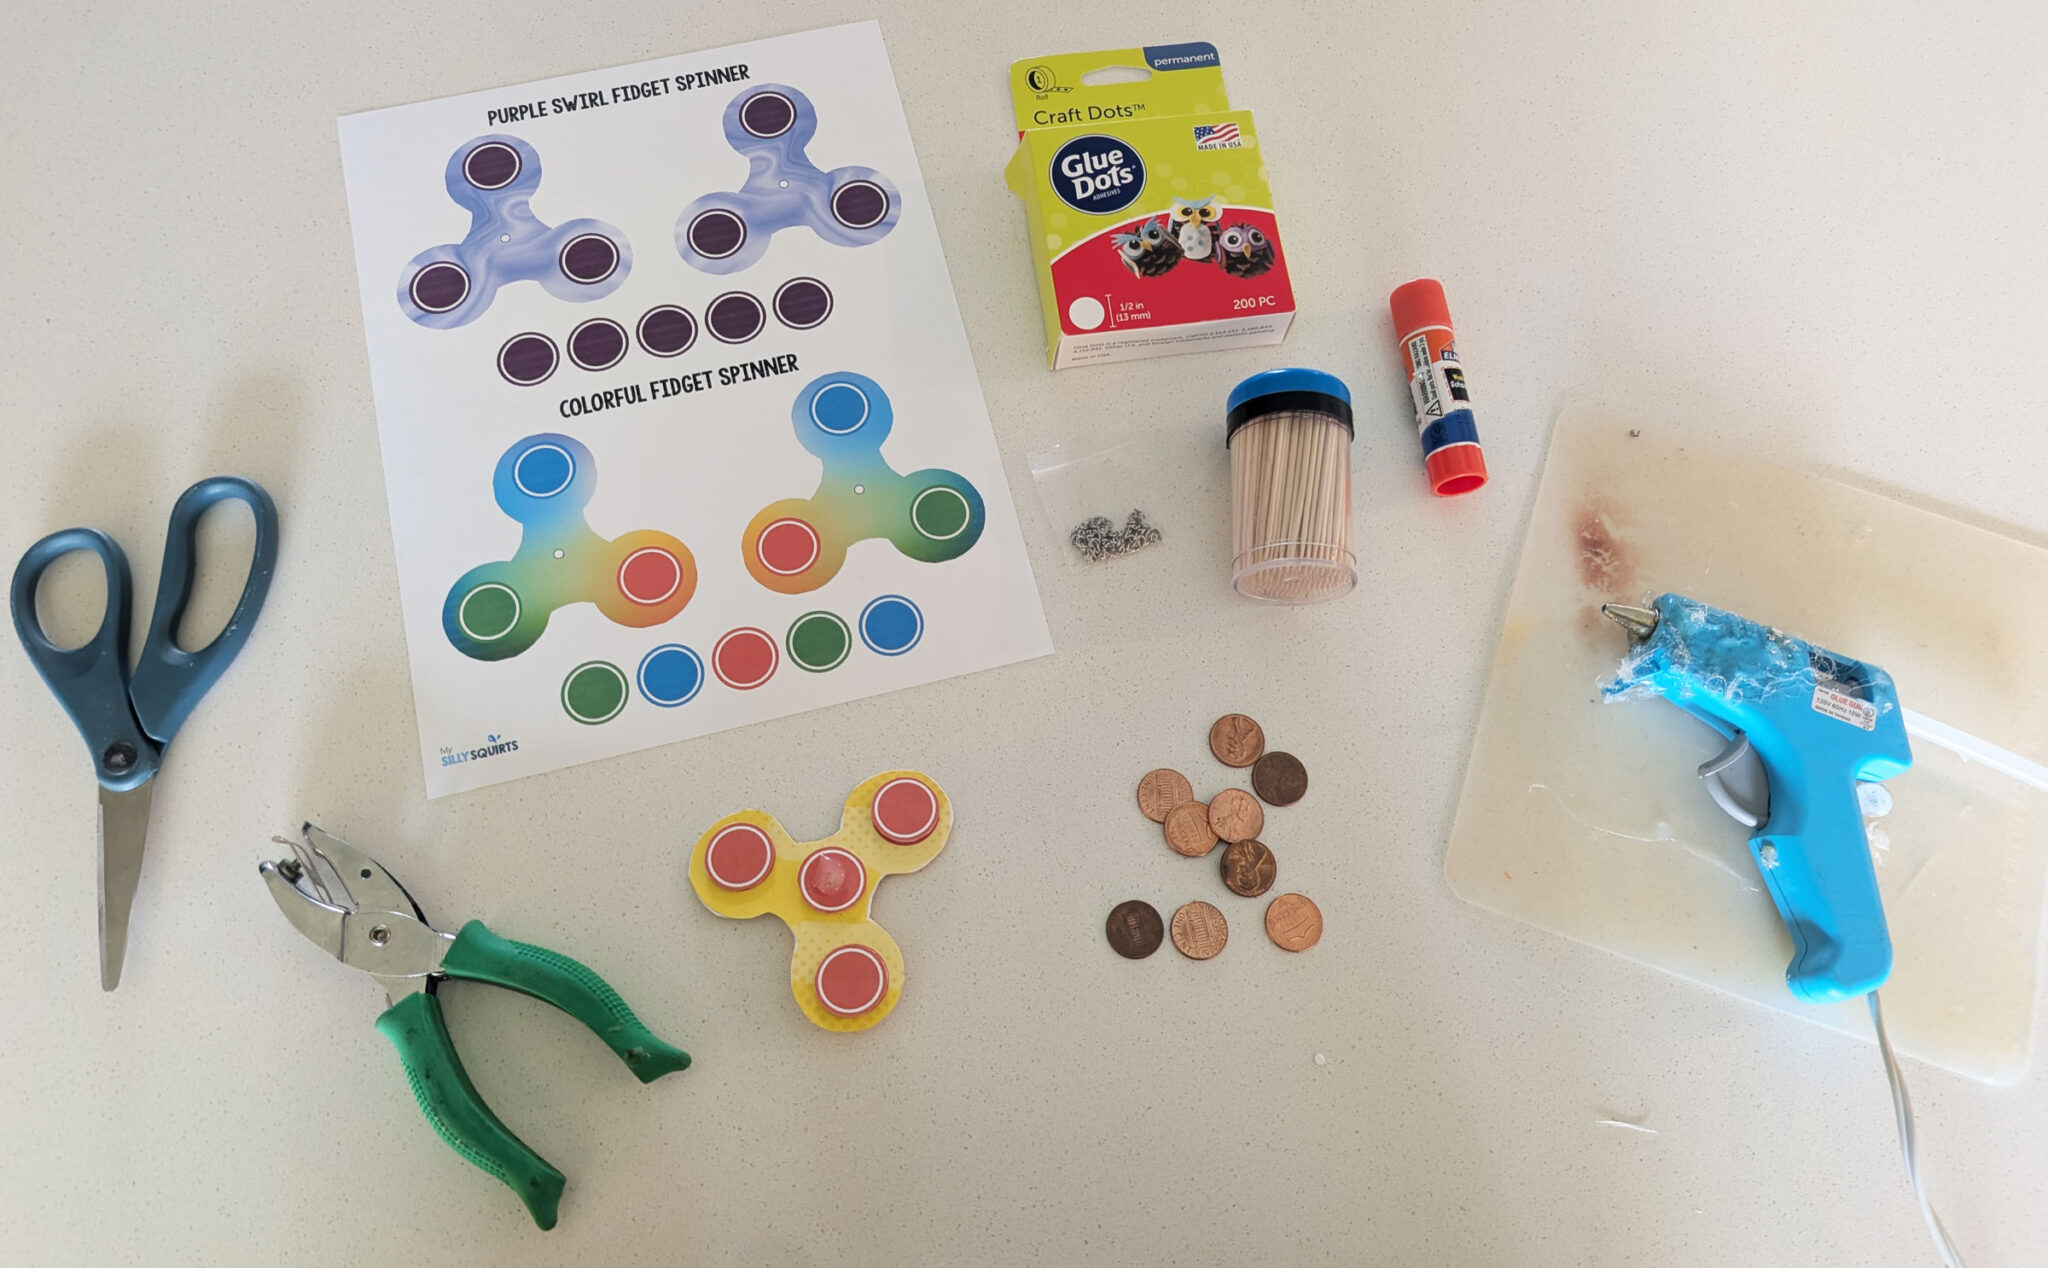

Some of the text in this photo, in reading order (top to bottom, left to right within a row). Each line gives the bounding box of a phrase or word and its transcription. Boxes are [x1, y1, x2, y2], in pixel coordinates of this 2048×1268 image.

[1154, 53, 1216, 67] permanent
[488, 64, 751, 126] PURPLE SWIRL FIDGET SPINNER
[1033, 108, 1082, 125] Craft
[1198, 140, 1242, 151] MADE IN USA
[1061, 149, 1124, 178] Glue
[1092, 188, 1121, 201] ADHESIVES
[1119, 302, 1144, 312] 1/2 in
[1233, 295, 1276, 310] 200 PC
[1116, 311, 1151, 323] (13 mm)
[559, 354, 800, 418] COLORFUL FIDGET SPINNER
[1816, 697, 1831, 706] 120V
[1832, 703, 1847, 713] 60Hz
[1831, 693, 1863, 711] GLUE GUN
[440, 746, 453, 755] My
[441, 740, 519, 767] SILLY SQUIRTS
